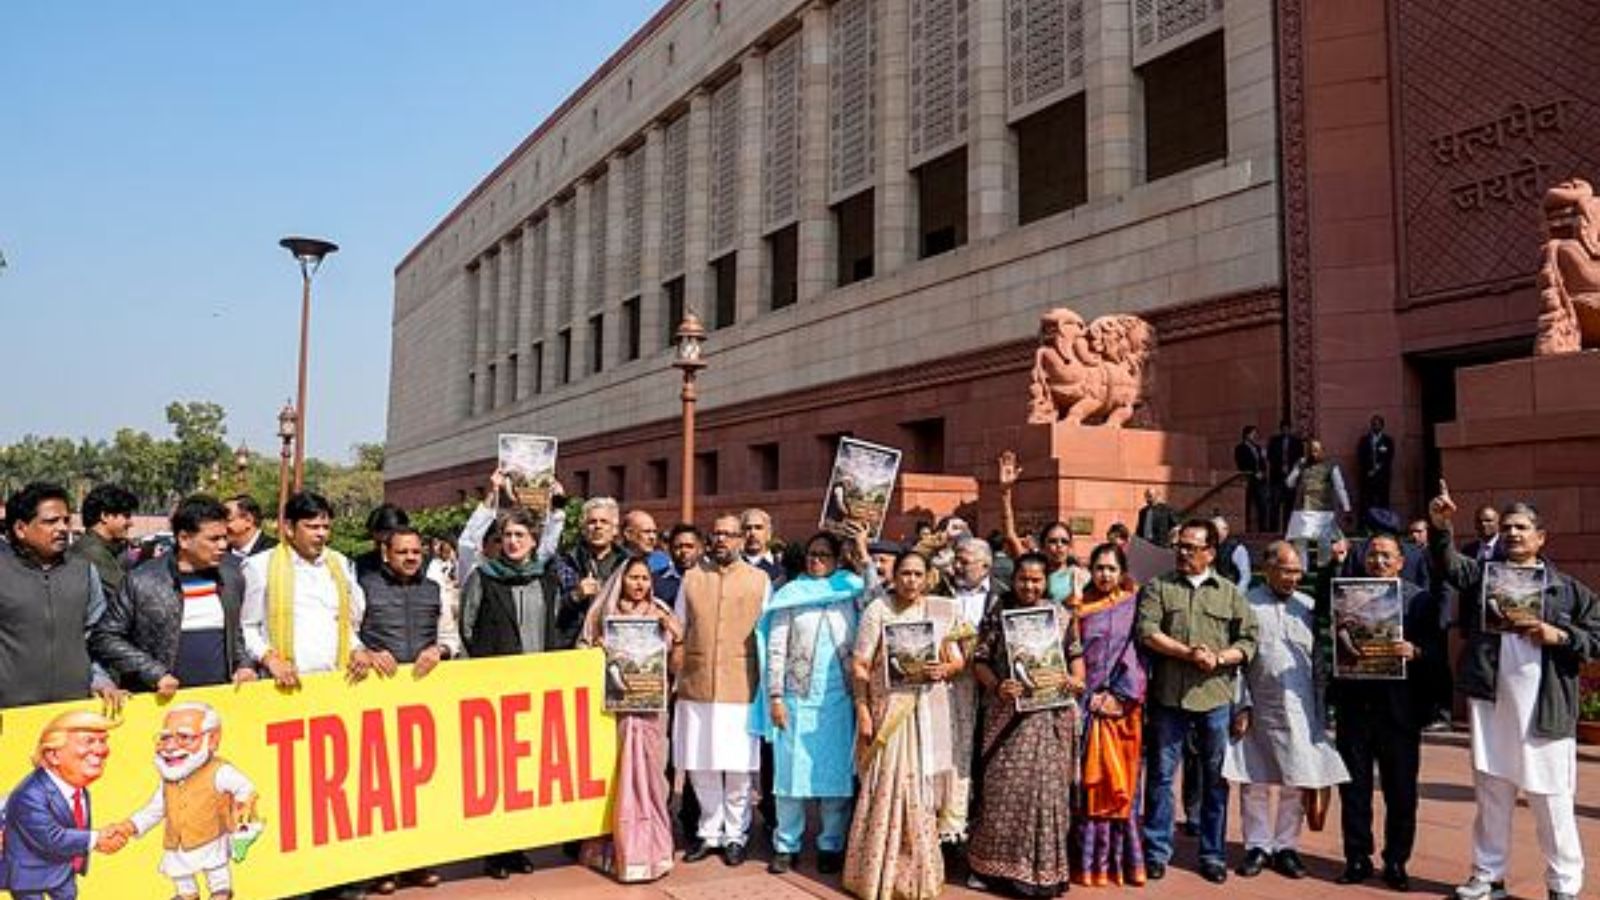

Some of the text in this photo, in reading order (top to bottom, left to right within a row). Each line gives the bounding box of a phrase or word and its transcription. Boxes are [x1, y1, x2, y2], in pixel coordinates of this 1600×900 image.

[1430, 101, 1570, 165] सत्यमेव
[1451, 153, 1553, 211] जयते
[266, 686, 606, 853] TRAP DEAL
